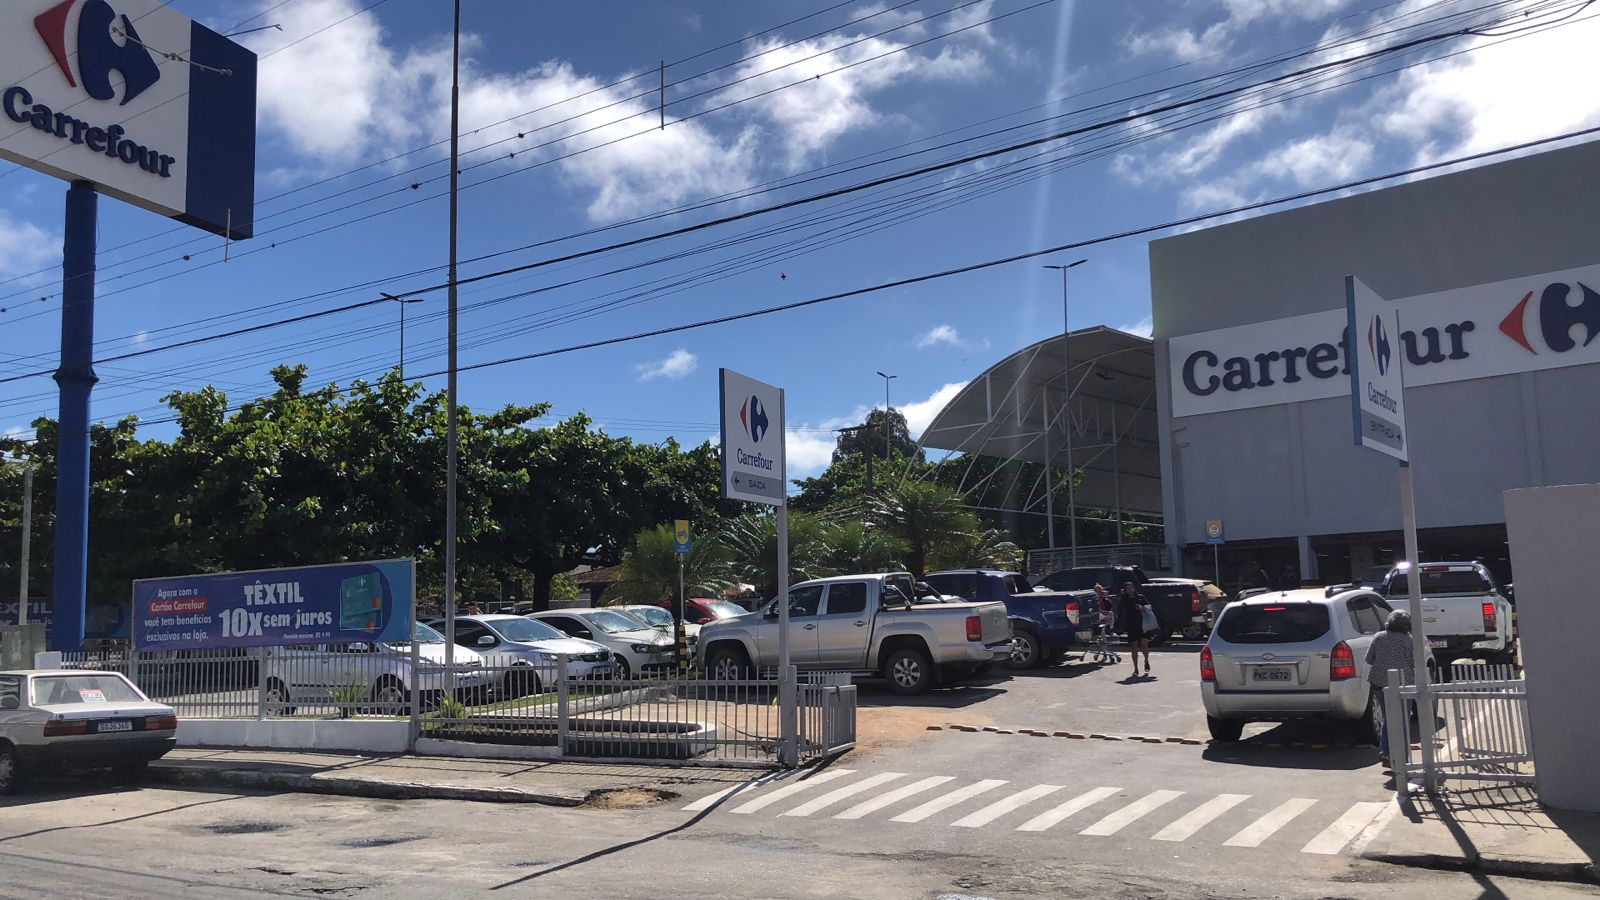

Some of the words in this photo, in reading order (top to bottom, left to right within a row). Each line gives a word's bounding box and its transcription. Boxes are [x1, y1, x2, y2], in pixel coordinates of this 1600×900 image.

[3, 86, 175, 178] Carrefour
[1182, 320, 1475, 396] Carrefur
[1368, 382, 1397, 414] Carrefour
[737, 447, 773, 471] Carrefour
[157, 589, 177, 600] Agora
[179, 588, 191, 596] com
[193, 588, 198, 596] o
[244, 580, 304, 605] TÊXTIL
[151, 602, 172, 612] Cartão
[173, 599, 205, 611] Carrefour
[144, 616, 159, 627] você
[161, 615, 174, 626] tem
[263, 613, 290, 627] sem
[295, 609, 332, 629] juros
[146, 630, 180, 642] exclusivos
[182, 632, 191, 640] na
[193, 629, 209, 642] loja.
